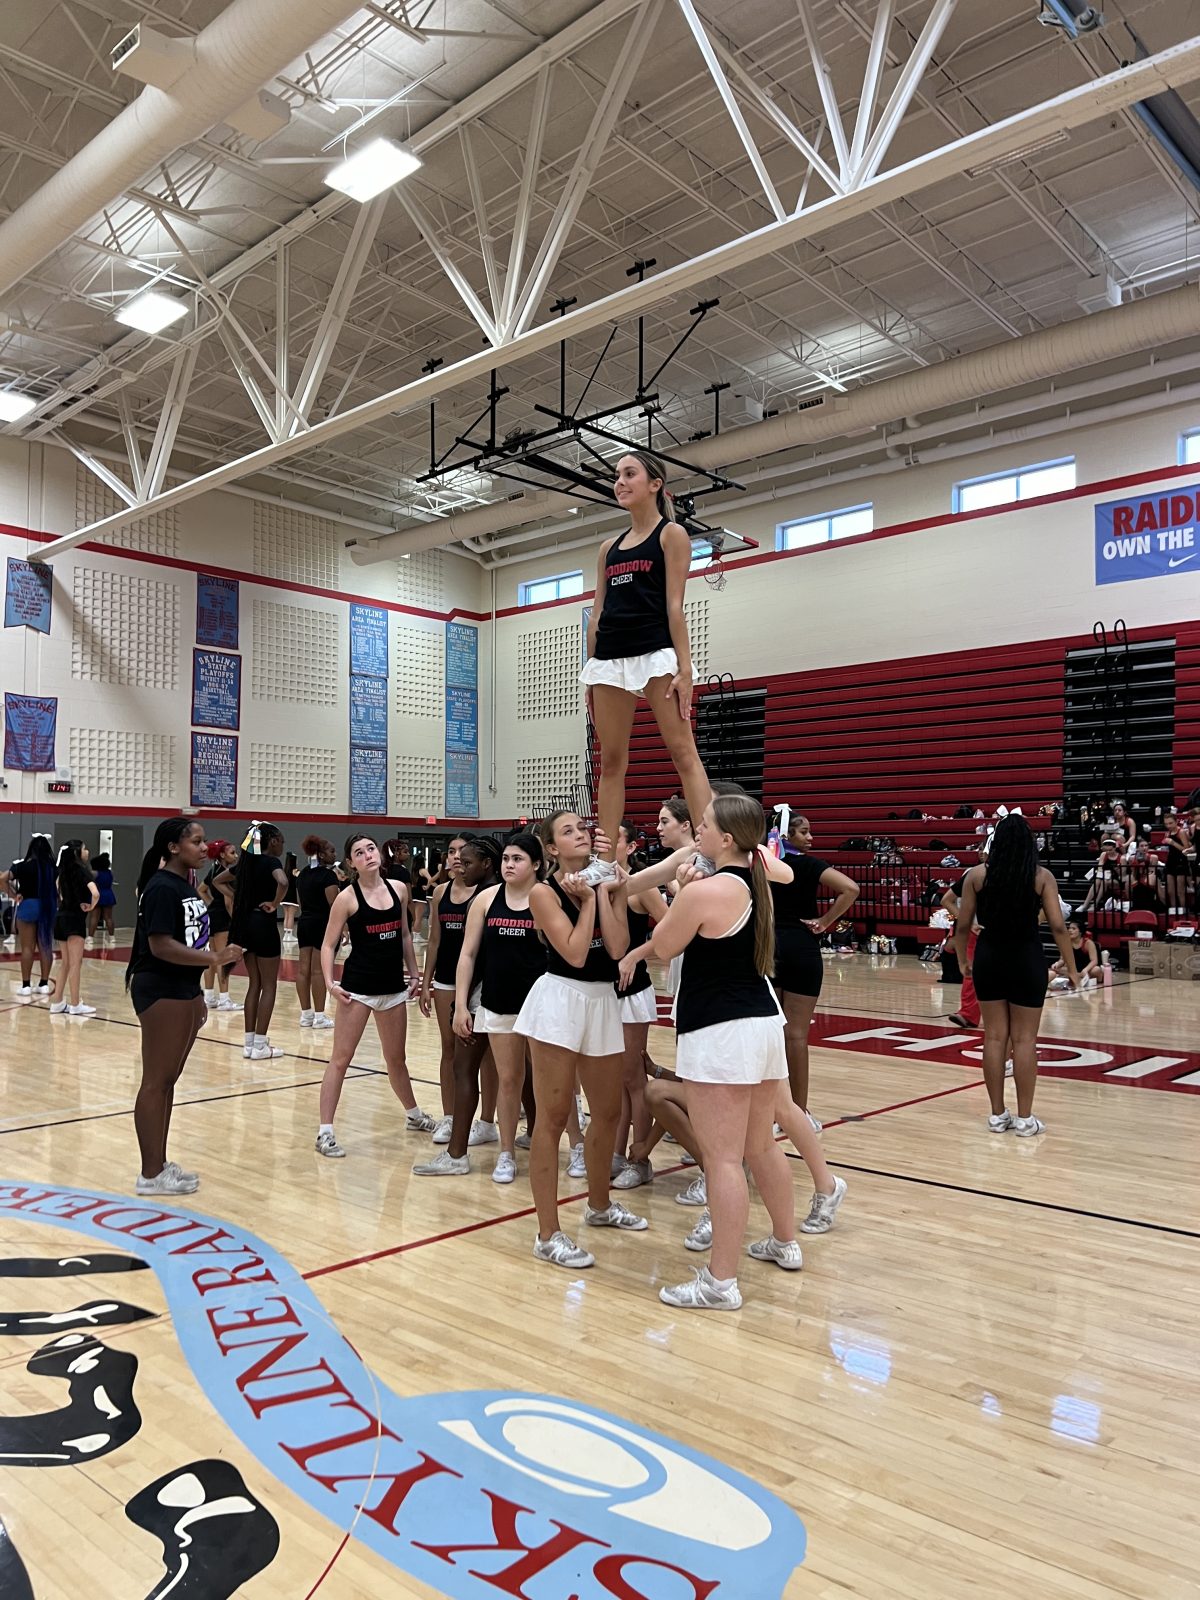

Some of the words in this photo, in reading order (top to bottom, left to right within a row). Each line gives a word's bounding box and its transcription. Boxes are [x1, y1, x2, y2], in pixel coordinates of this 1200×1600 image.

[1112, 491, 1200, 537] RAID
[1103, 534, 1151, 560] OWN
[1156, 526, 1194, 551] THE
[611, 573, 633, 586] CHEER
[355, 606, 384, 619] SKYLINE
[450, 625, 474, 636] SKYLINE
[198, 655, 236, 669] SKYLINE
[207, 662, 227, 672] STATE
[200, 668, 234, 679] PLAYOFFS
[355, 679, 383, 690] SKYLINE
[196, 735, 233, 747] SKYLINE
[198, 751, 232, 761] REGIONAL
[354, 748, 383, 758] SKYLINE
[379, 930, 397, 940] CHEER
[498, 927, 526, 936] CHEER
